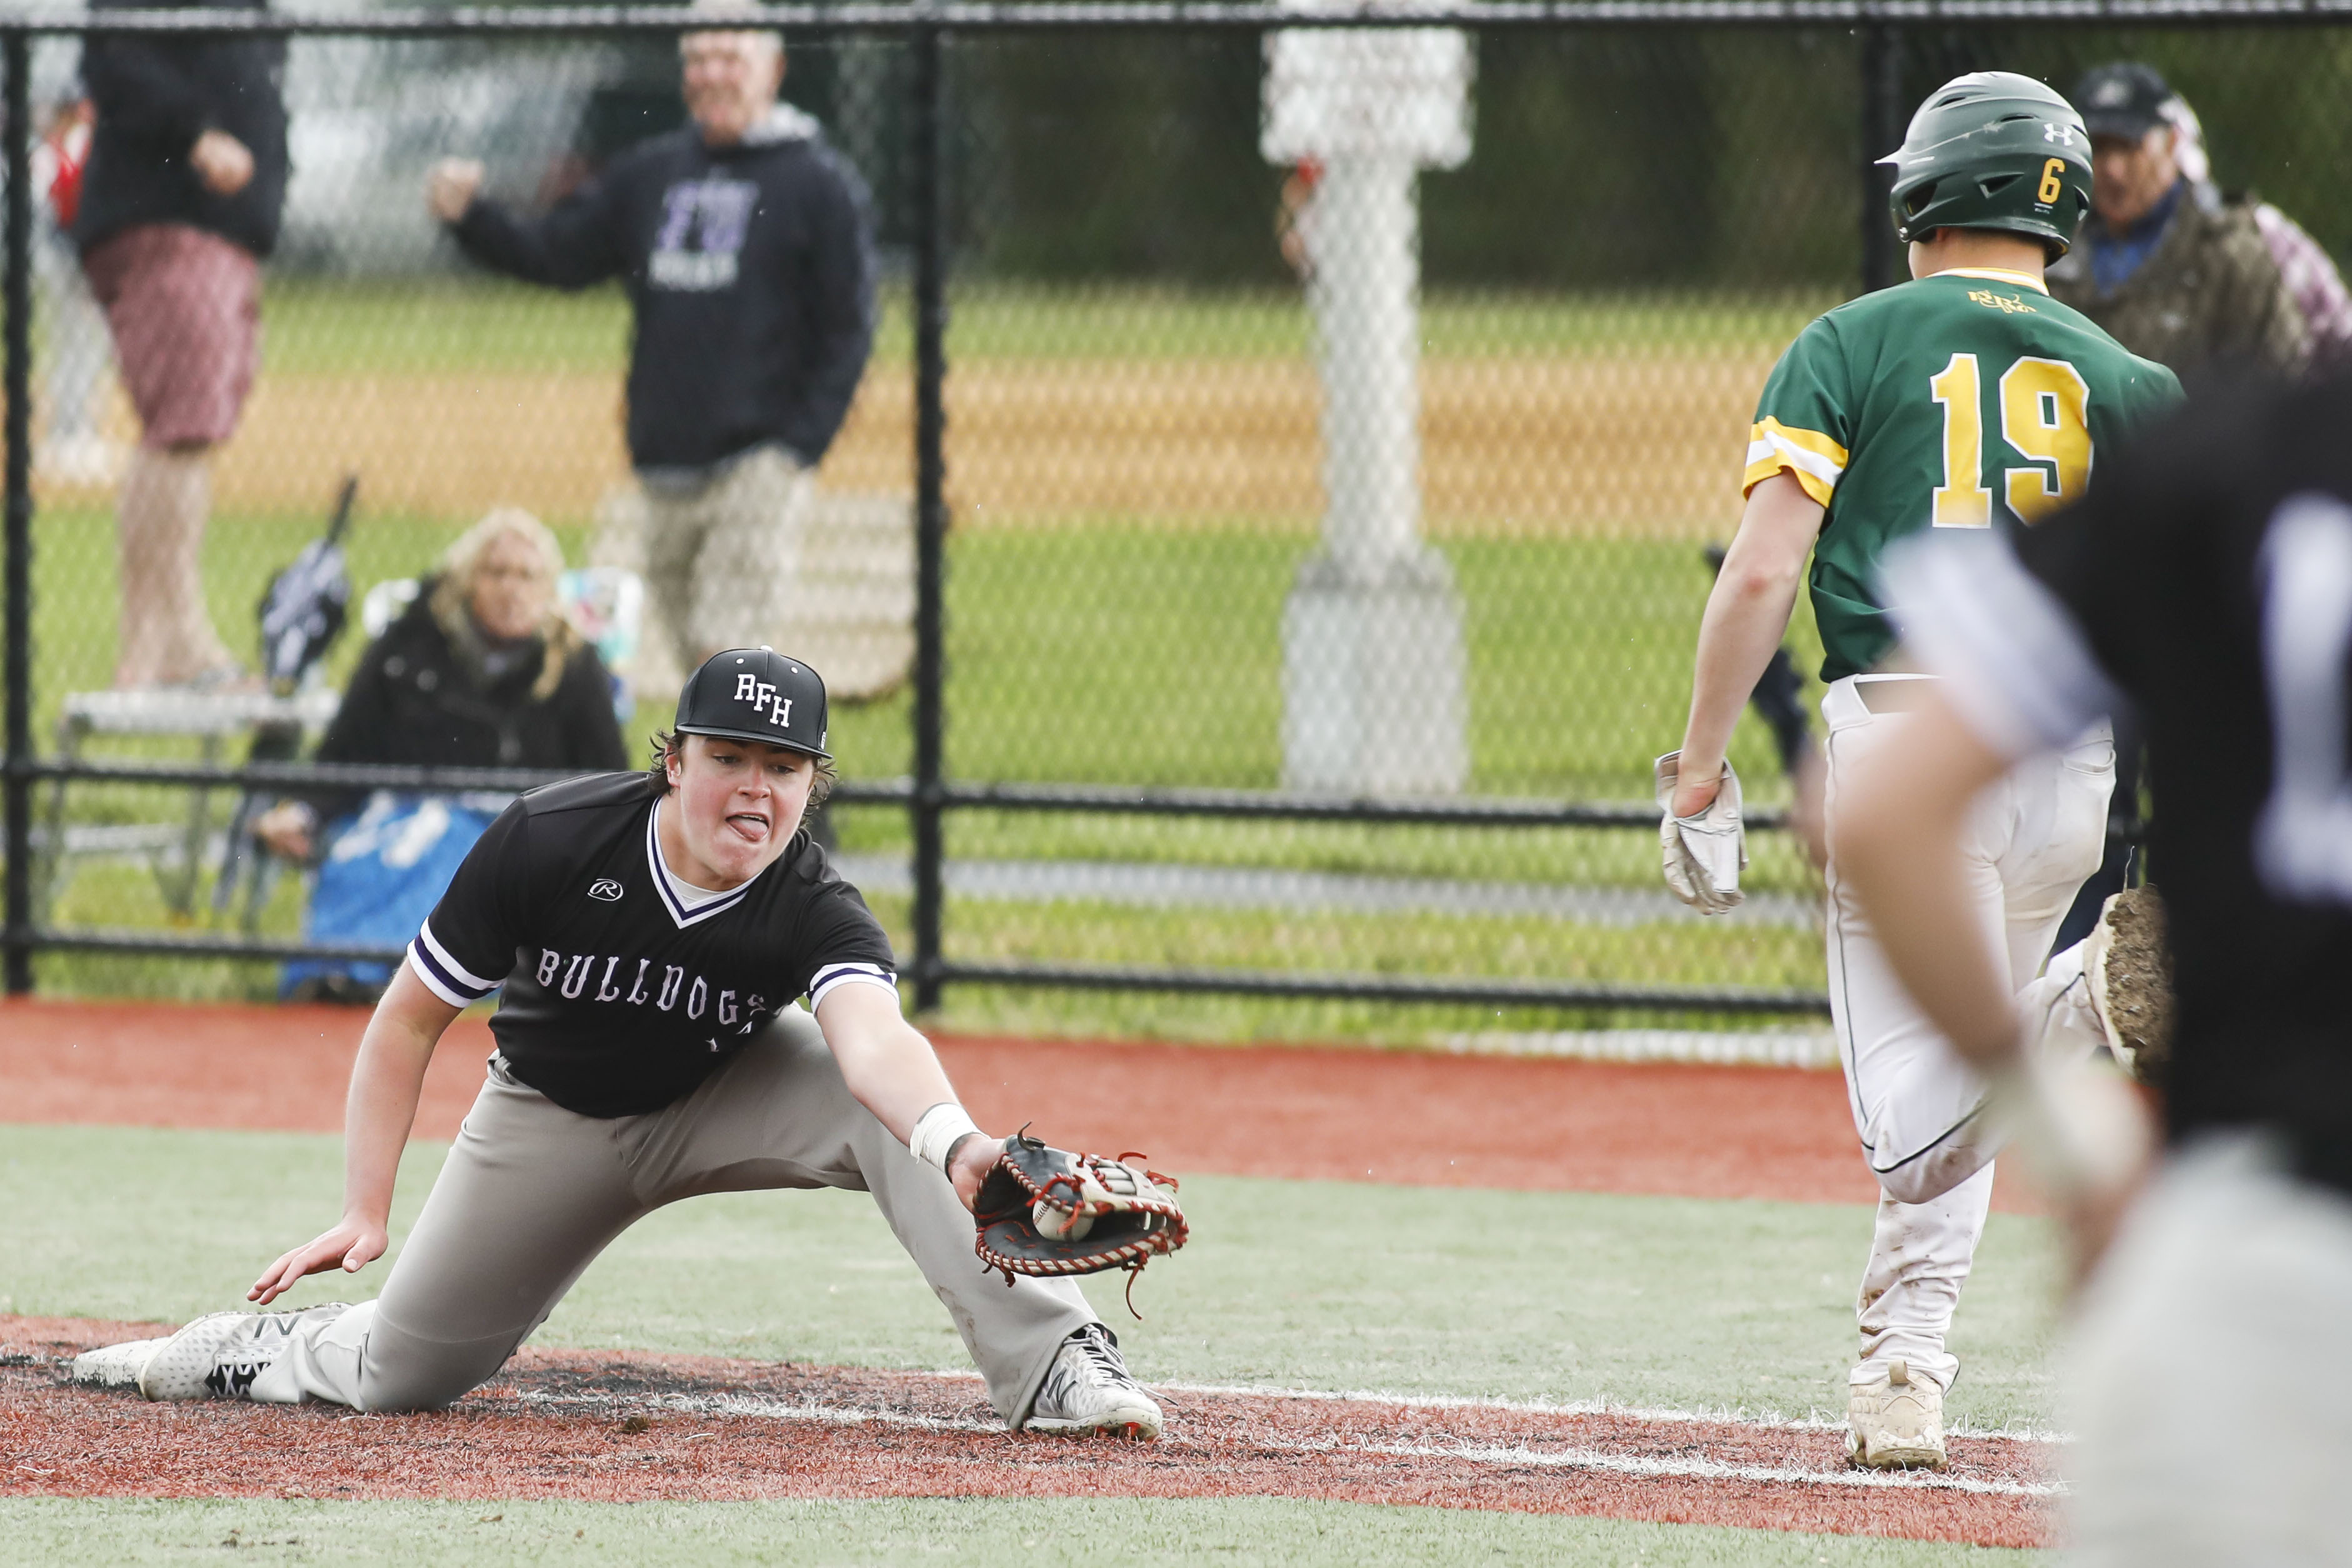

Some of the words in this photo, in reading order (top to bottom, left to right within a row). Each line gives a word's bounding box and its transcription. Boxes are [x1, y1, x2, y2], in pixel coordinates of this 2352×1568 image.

[2038, 157, 2065, 204] 6
[1929, 352, 2094, 529] 19
[734, 673, 793, 728] RFH
